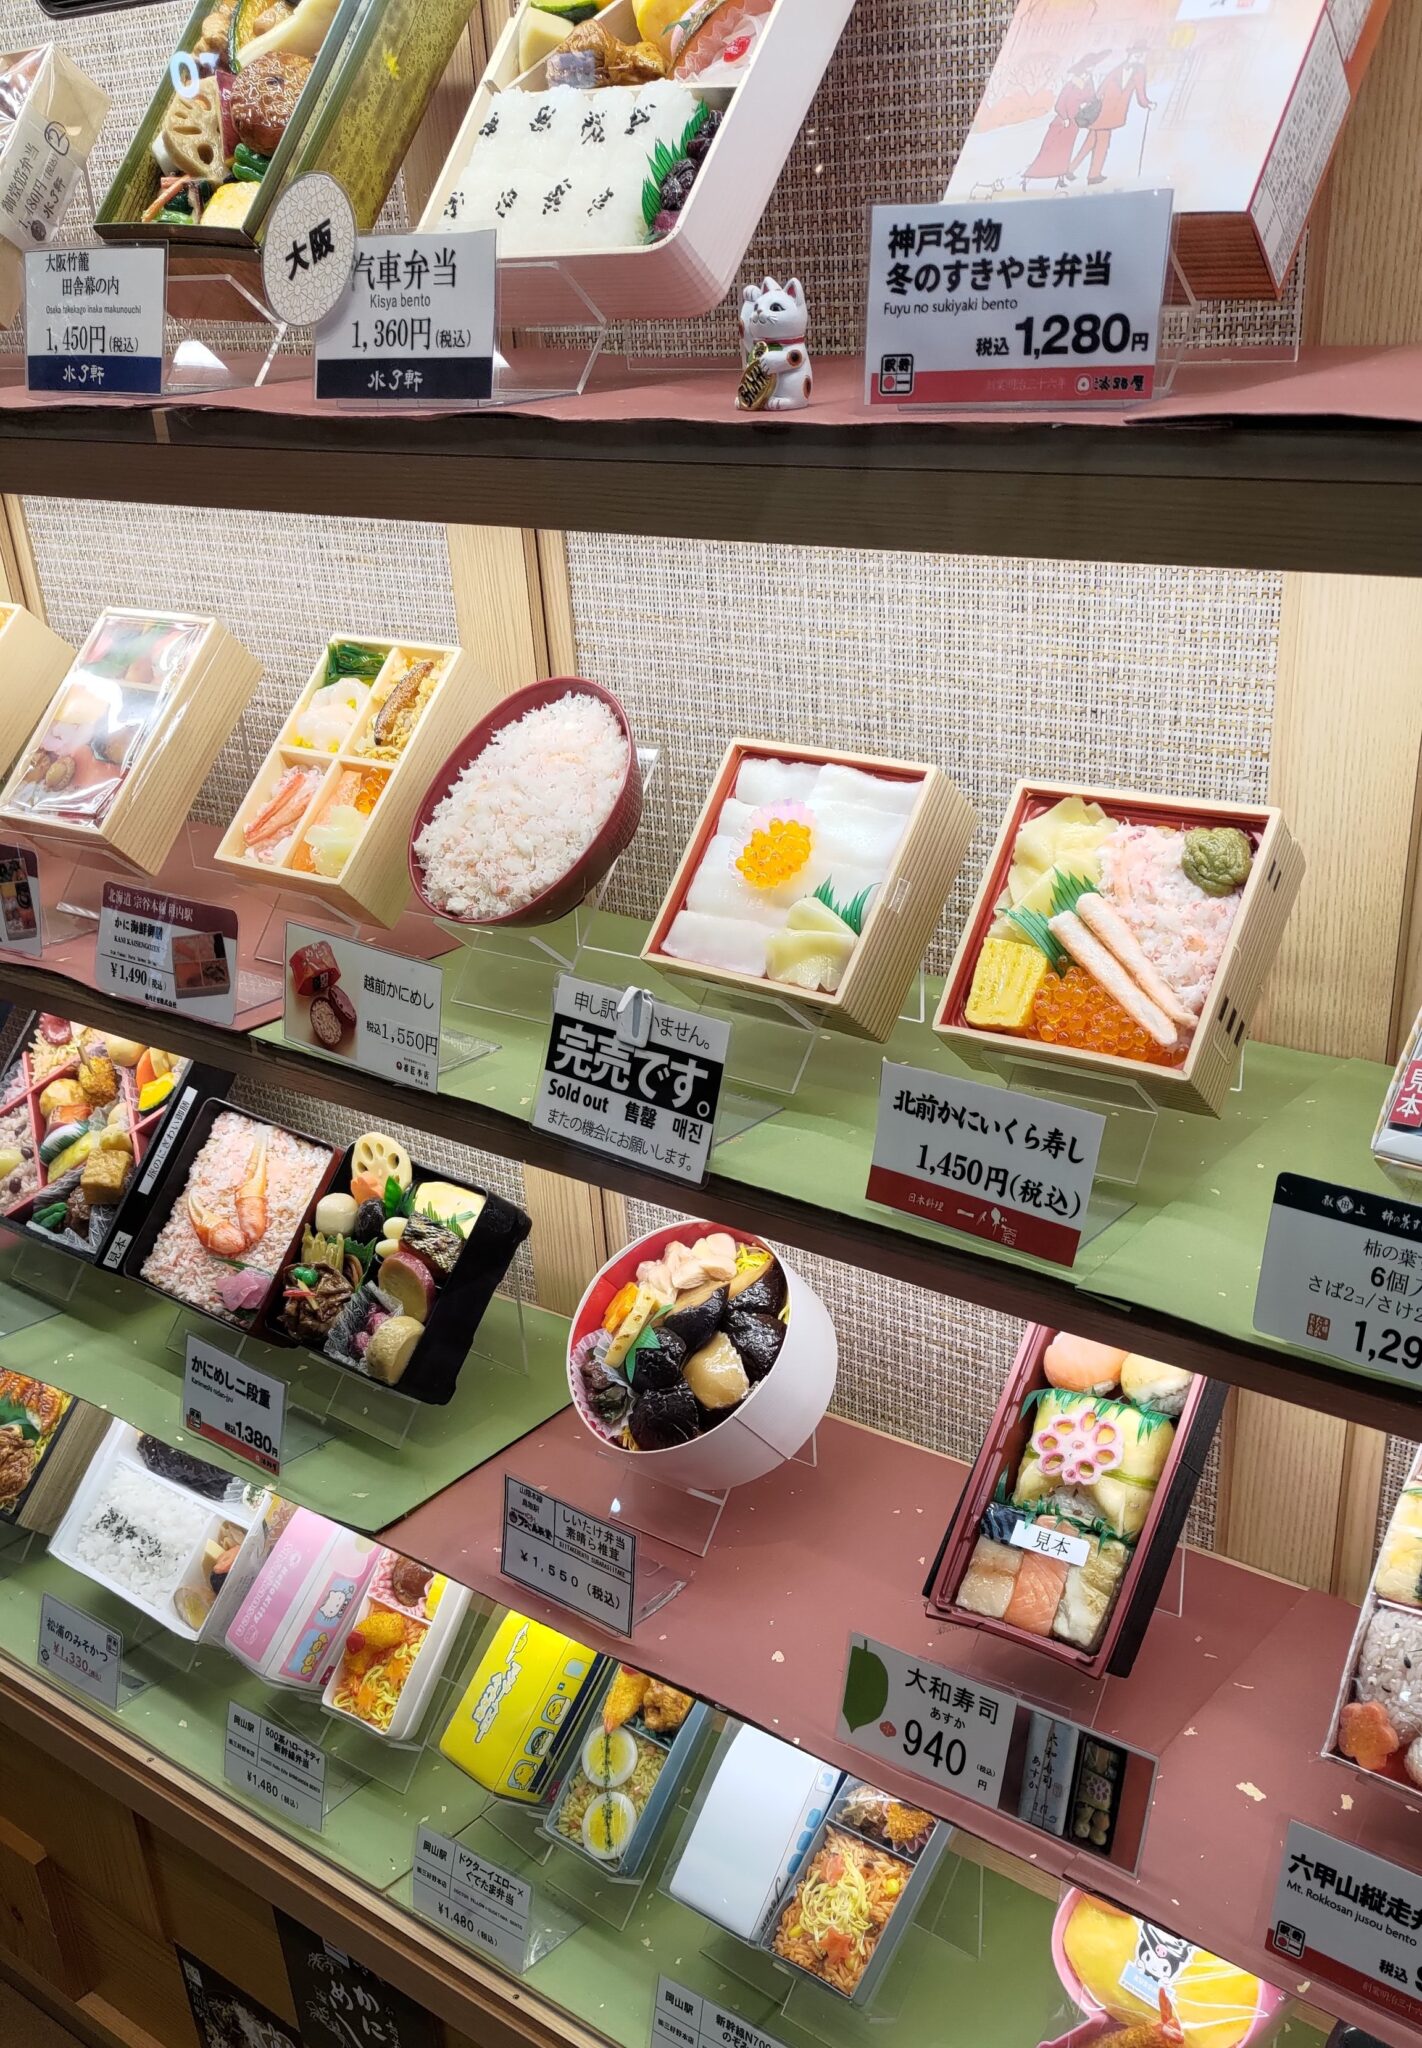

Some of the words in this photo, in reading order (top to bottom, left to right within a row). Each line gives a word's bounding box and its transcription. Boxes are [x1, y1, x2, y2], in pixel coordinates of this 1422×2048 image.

[286, 218, 335, 281] 大阪
[887, 219, 1002, 258] 神戸名物
[45, 252, 90, 273] 大阪竹籠
[886, 250, 1112, 296] 冬のすきやき弁当
[62, 276, 120, 296] 田舎幕の内
[370, 294, 398, 310] Kisya
[400, 293, 431, 308] bento
[46, 305, 62, 315] Osaka
[88, 305, 103, 314] inaka
[104, 305, 142, 315] makunouchi
[884, 302, 911, 319] Fuyu
[914, 303, 929, 314] no
[932, 298, 979, 314] sukiyaki
[982, 297, 1018, 311] bento
[976, 336, 1010, 357] 税込
[1015, 313, 1148, 360] 1,280円
[108, 889, 131, 906] 北海道
[363, 974, 435, 1010] 越前かにめし
[553, 1023, 711, 1118] 完売です。
[548, 1078, 582, 1104] Sold
[583, 1093, 610, 1113] out
[1396, 1069, 1422, 1118] 見本
[624, 1101, 657, 1130] 售罄
[672, 1118, 703, 1145] 매진
[893, 1090, 1085, 1164] 北前かにいくら寿し
[547, 1108, 693, 1172] またの機会にお願いします。
[107, 1237, 127, 1266] 見本
[1363, 1238, 1422, 1269] 柿の葉
[191, 1356, 271, 1410] かにめし二段重
[562, 1509, 625, 1551] しいたけ弁当
[566, 1526, 620, 1562] 素晴ら椎茸
[1032, 1530, 1071, 1556] 見本
[905, 1667, 1000, 1725] 大和寿司
[929, 1706, 966, 1731] あすか
[903, 1719, 967, 1776] 940
[978, 1778, 988, 1792] 円
[423, 1840, 448, 1862] 岡山駅
[466, 1871, 514, 1907] ぐでたま弁当
[1286, 1879, 1304, 1896] Mt.
[1305, 1888, 1353, 1918] Rokkosan
[1354, 1910, 1383, 1932] jusou
[1385, 1923, 1417, 1947] bento
[1379, 1959, 1408, 1985] 税込
[665, 1990, 694, 2016] 岡山駅
